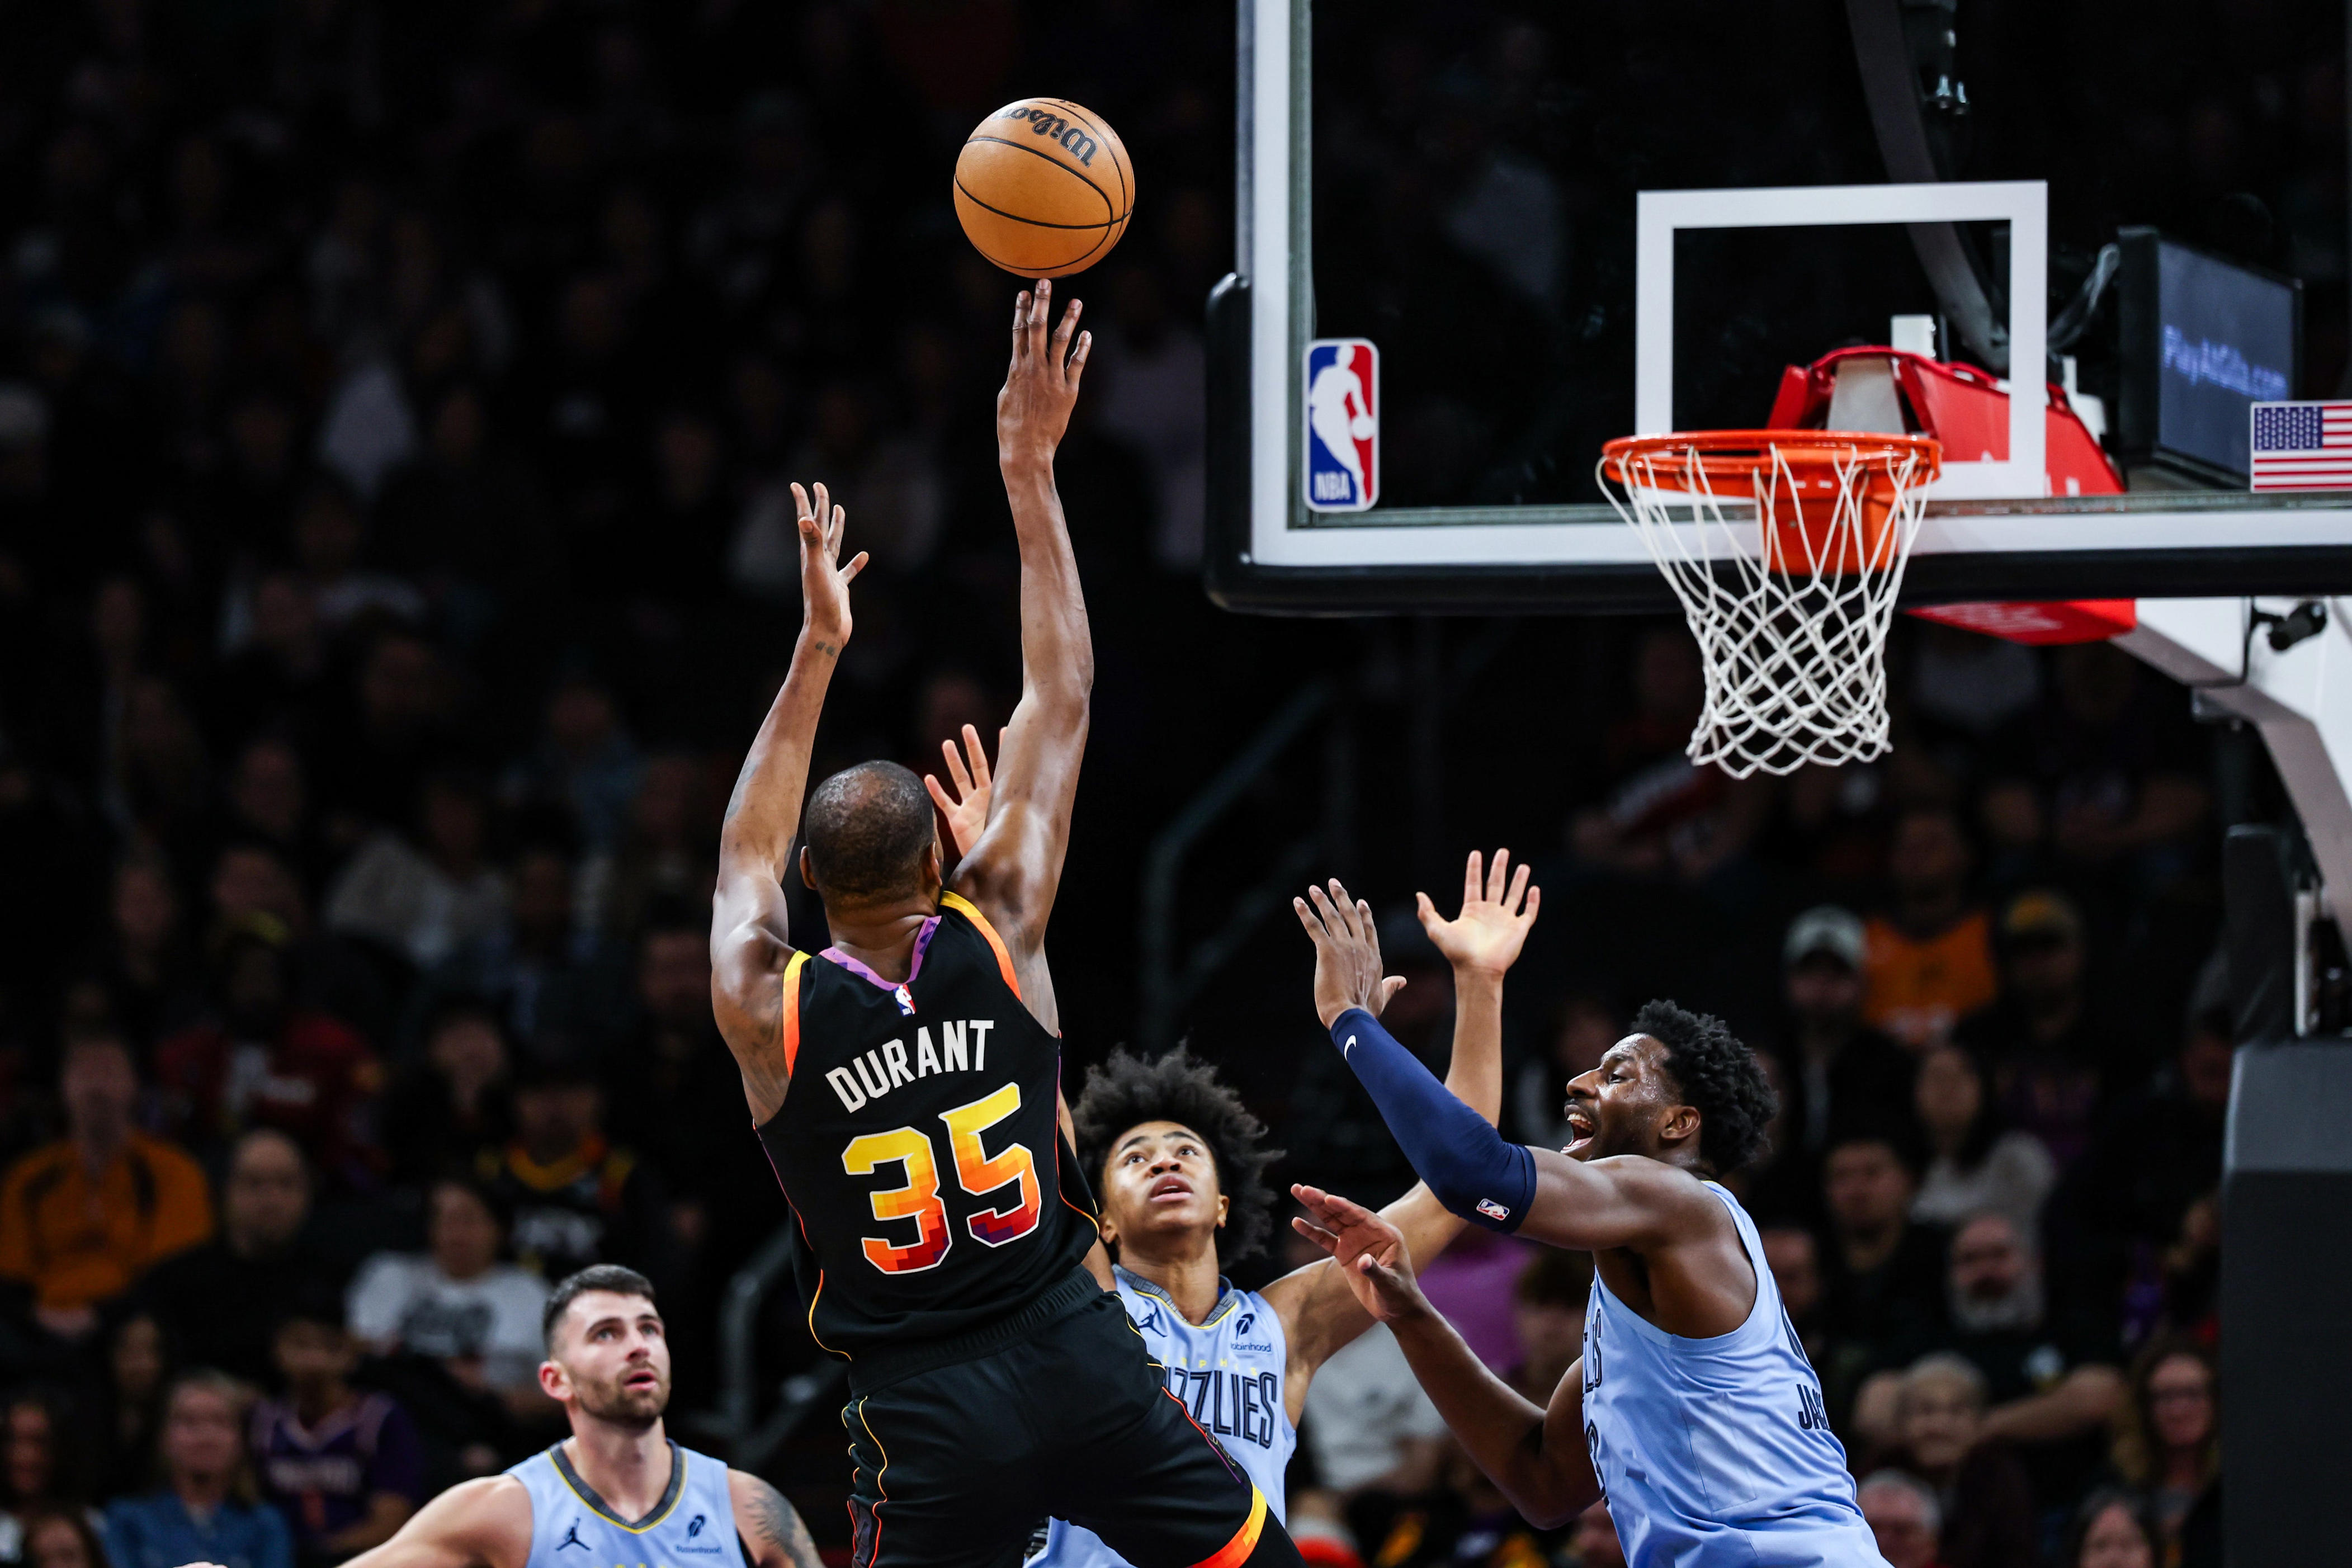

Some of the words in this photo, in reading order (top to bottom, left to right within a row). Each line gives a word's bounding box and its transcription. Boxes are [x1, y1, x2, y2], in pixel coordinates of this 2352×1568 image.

[1315, 471, 1351, 500] NBA
[825, 1019, 994, 1113] DURANT
[842, 1082, 1042, 1274] 35
[1164, 1366, 1277, 1449] ZZLIES
